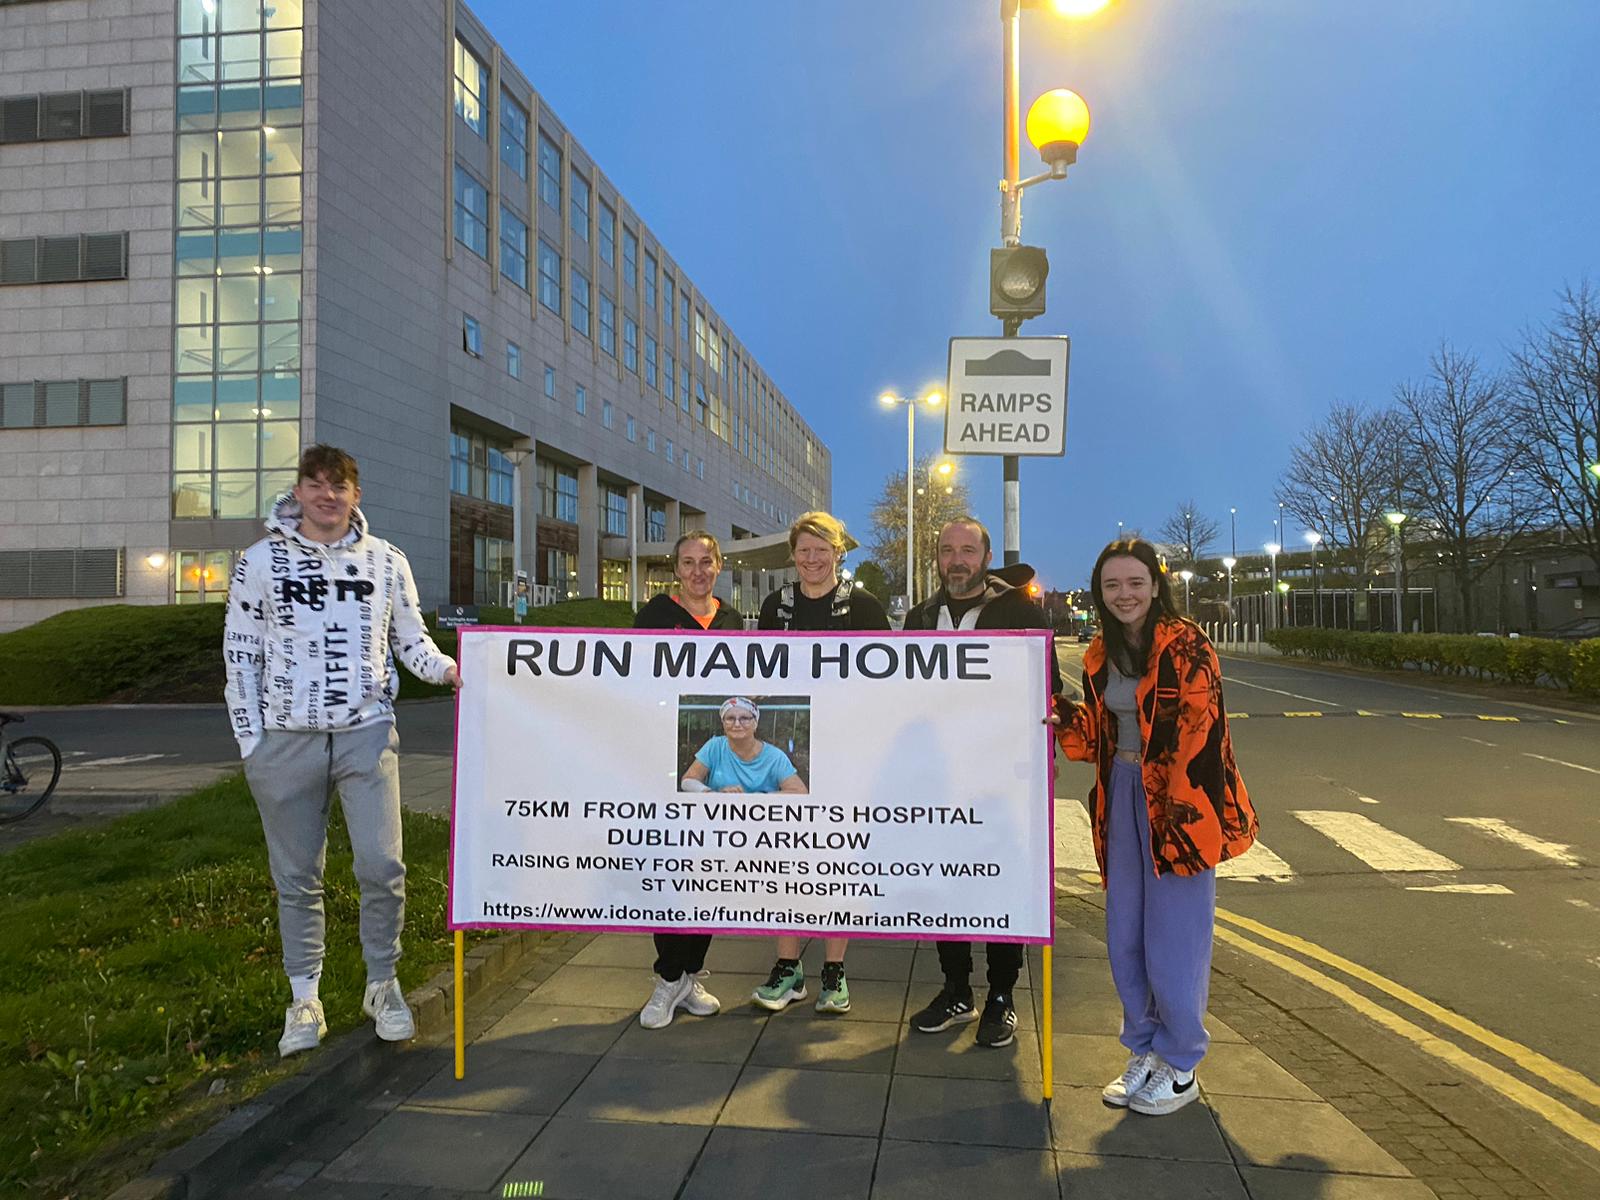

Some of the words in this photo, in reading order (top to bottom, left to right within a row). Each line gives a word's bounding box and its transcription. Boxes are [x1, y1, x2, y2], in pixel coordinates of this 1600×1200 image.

[960, 393, 1052, 413] RAMPS
[959, 422, 1050, 442] AHEAD
[507, 639, 632, 678] RUN
[653, 641, 789, 679] MAM
[811, 642, 992, 680] HOME
[504, 800, 569, 818] 75KM
[583, 801, 657, 820] FROM
[664, 802, 697, 820] ST
[703, 803, 845, 823] VINCENT’S
[853, 805, 984, 825] HOSPITAL
[607, 828, 705, 847] DUBLIN
[712, 830, 748, 848] TO
[754, 831, 871, 850] ARKLOW
[492, 853, 570, 869] RAISING
[576, 856, 647, 872] MONEY
[653, 858, 694, 873] FOR
[700, 859, 729, 873] ST.
[734, 859, 810, 875] ANNE’S
[816, 861, 934, 877] ONCOLOGY
[939, 863, 1001, 877] WARD
[641, 878, 666, 892] ST
[671, 878, 778, 894] VINCENT’S
[785, 881, 886, 897] HOSPITAL
[483, 901, 1010, 929] https://www.idonate.ie/fundraiser/MarianRedmond
